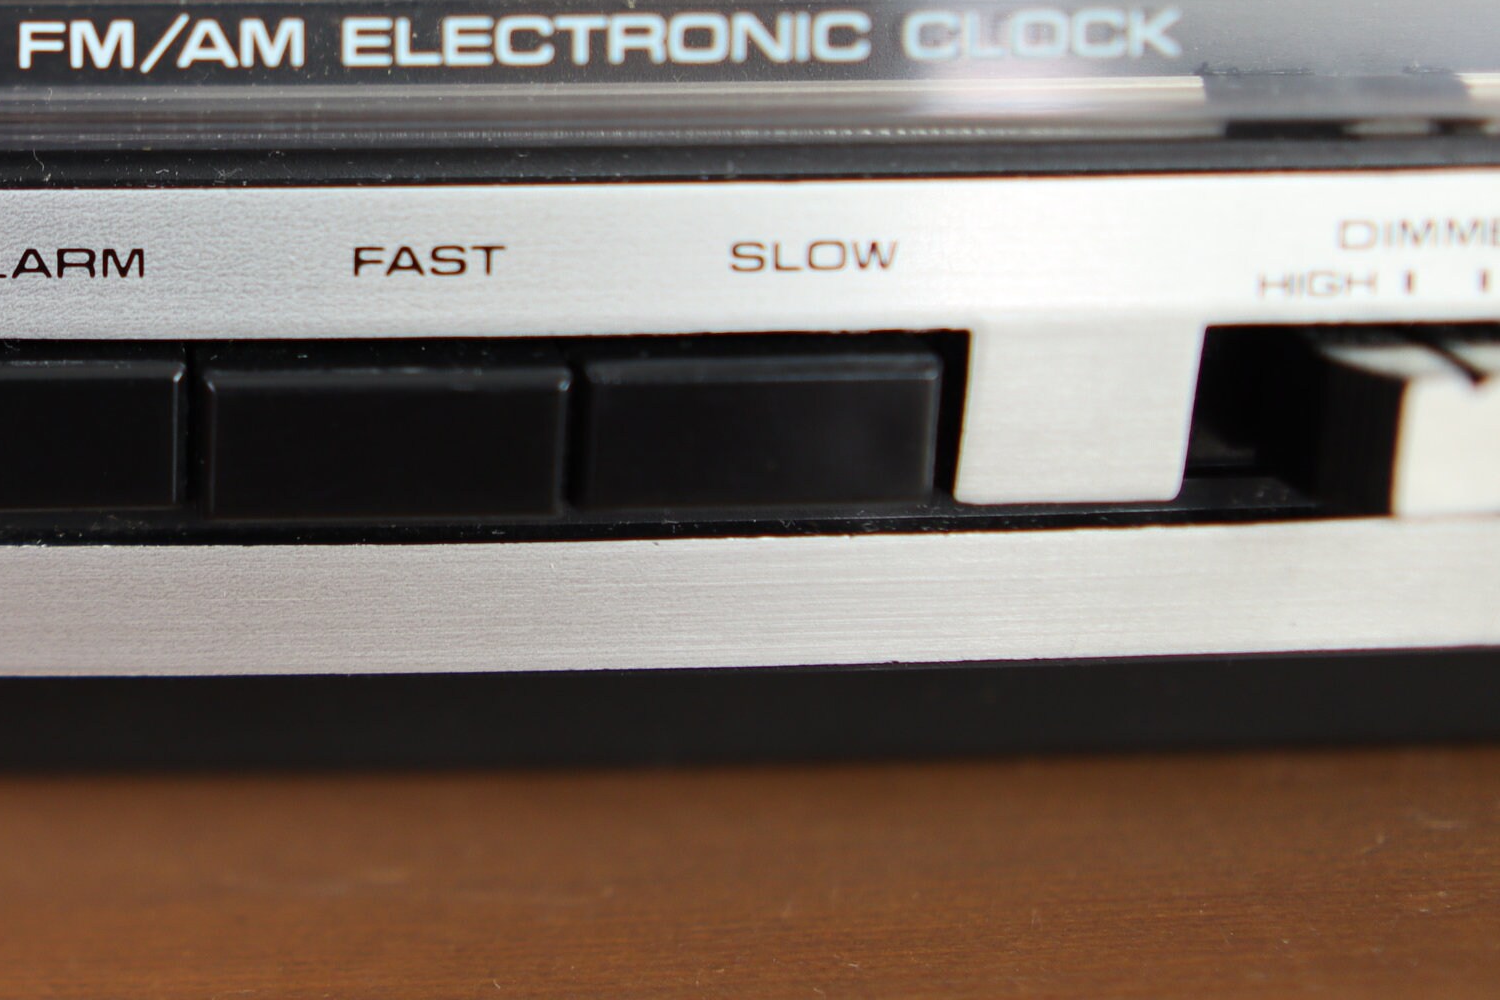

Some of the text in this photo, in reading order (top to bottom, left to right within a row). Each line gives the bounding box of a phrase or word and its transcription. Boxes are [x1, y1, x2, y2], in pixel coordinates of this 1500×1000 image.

[17, 7, 1185, 74] FM/AM ELECTRONIC CLOCK
[352, 244, 506, 277] FAST
[729, 240, 898, 273] SLOW
[1257, 268, 1378, 299] HIGH
